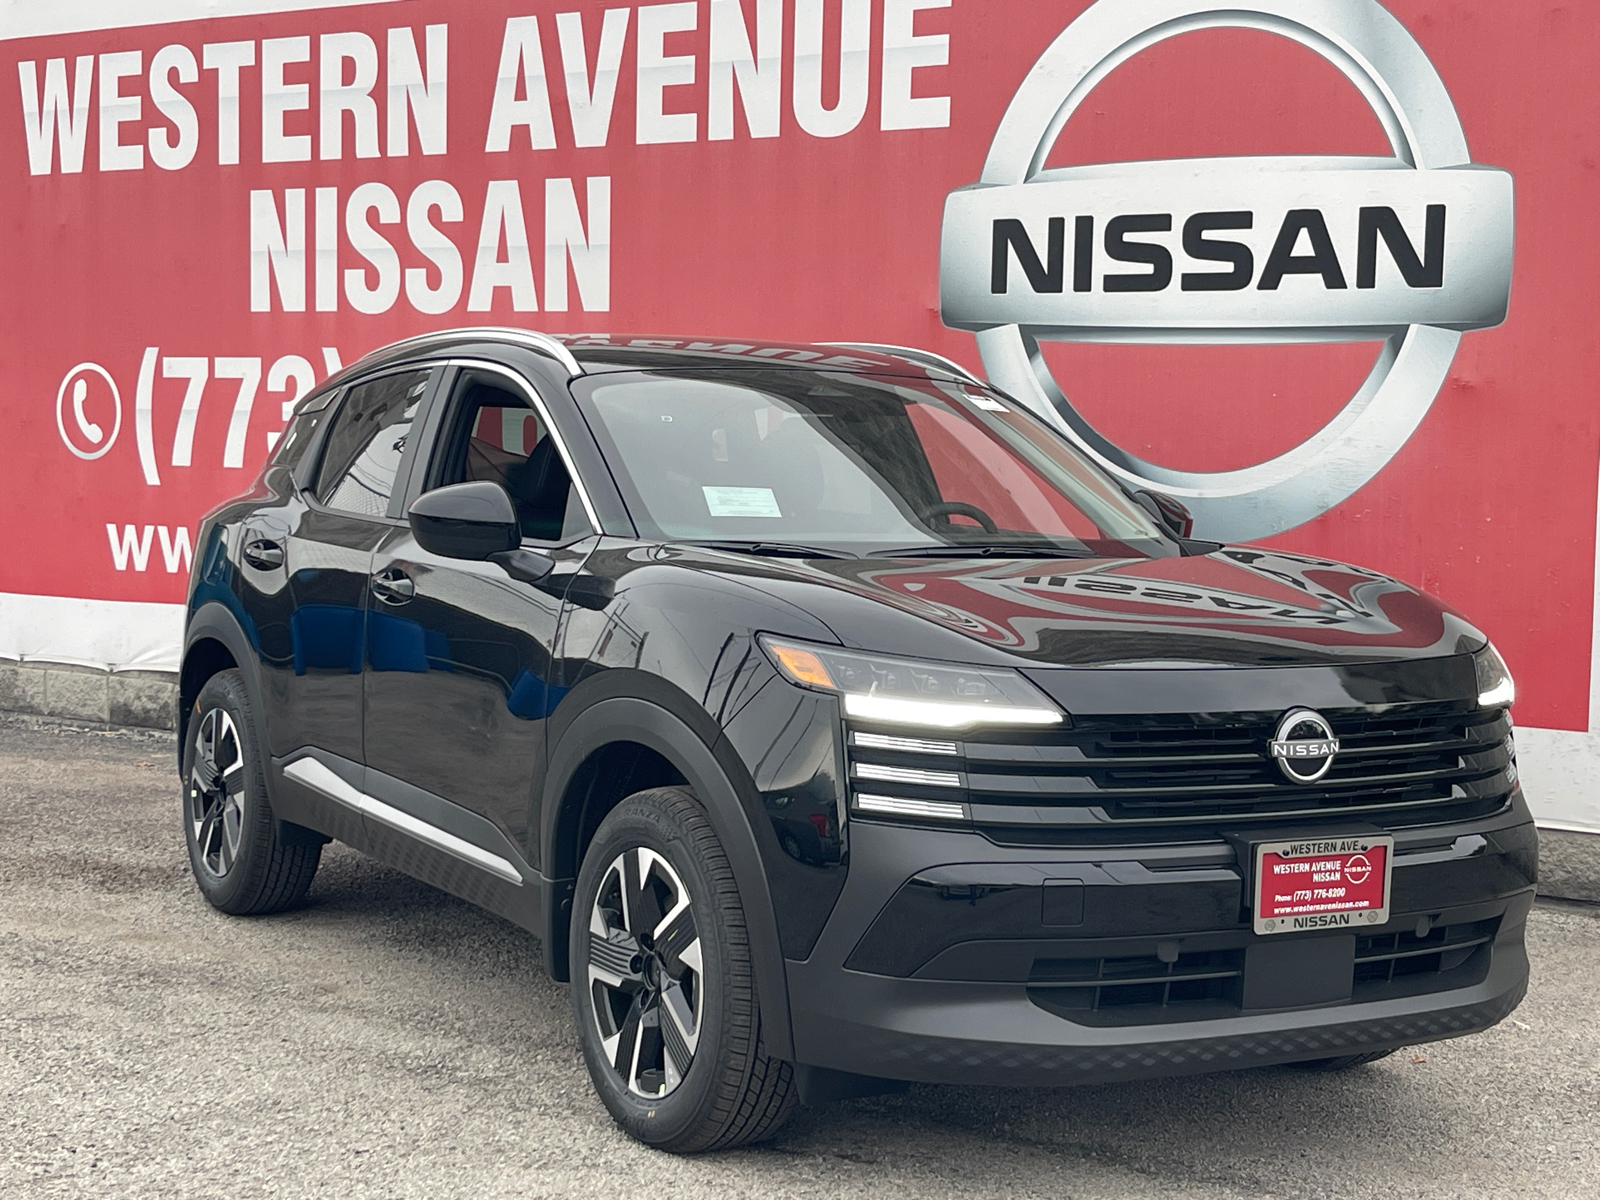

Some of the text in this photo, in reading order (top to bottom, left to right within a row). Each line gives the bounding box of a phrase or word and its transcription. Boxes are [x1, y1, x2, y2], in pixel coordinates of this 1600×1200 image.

[18, 0, 953, 176] WESTERN AVENUE
[249, 176, 611, 314] NISSAN
[991, 204, 1447, 294] NISSAN
[1274, 741, 1339, 756] NISSAN
[1290, 840, 1361, 855] WESTERN AVE.
[1273, 860, 1341, 875] WESTERN AVENUE
[1344, 865, 1372, 873] NISSAN
[1313, 871, 1341, 882] NISSAN
[1293, 890, 1312, 902] (773)
[1313, 887, 1346, 899] 776-8200
[1273, 901, 1370, 914] www.westernavenissan.com
[1293, 914, 1350, 929] NISSAN
